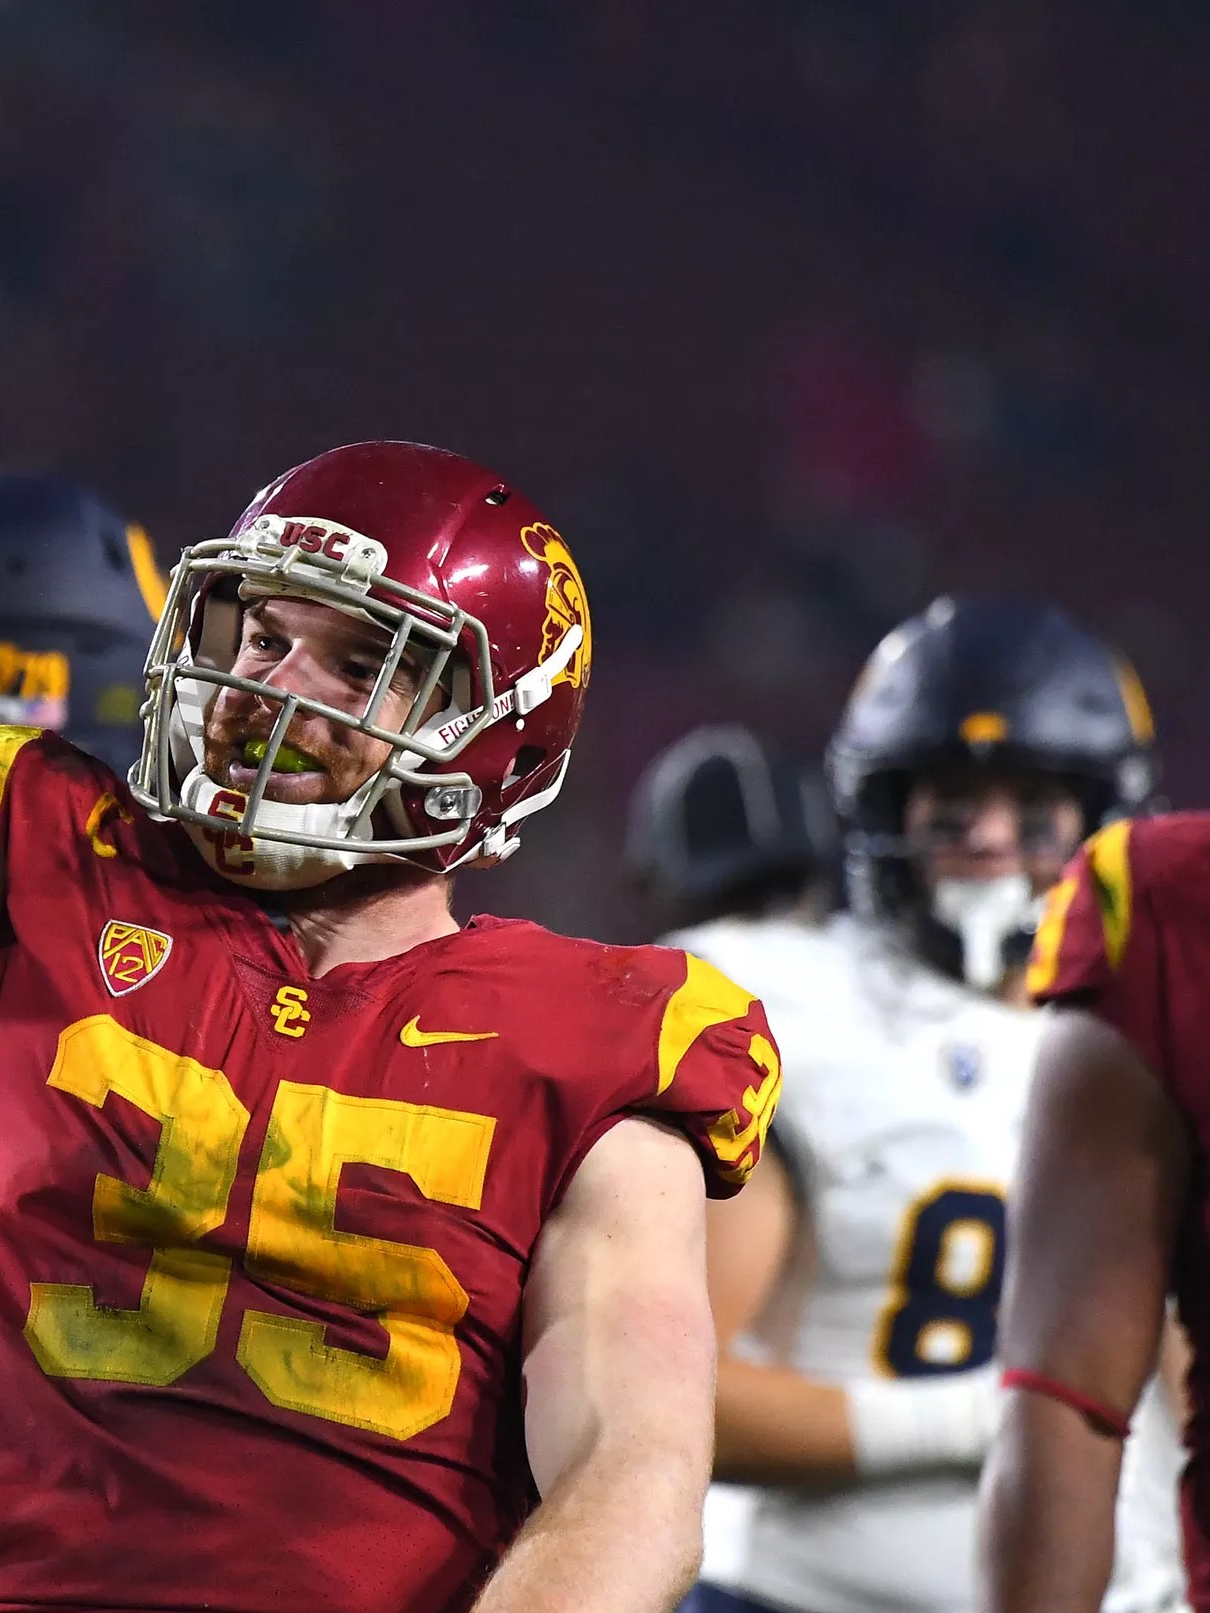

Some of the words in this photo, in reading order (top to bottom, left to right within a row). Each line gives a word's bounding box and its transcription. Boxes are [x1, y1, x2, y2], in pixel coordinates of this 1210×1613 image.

[280, 521, 351, 562] USC
[103, 924, 169, 974] PAC
[108, 952, 138, 983] 12
[271, 986, 311, 1038] SC
[23, 1014, 496, 1441] 35
